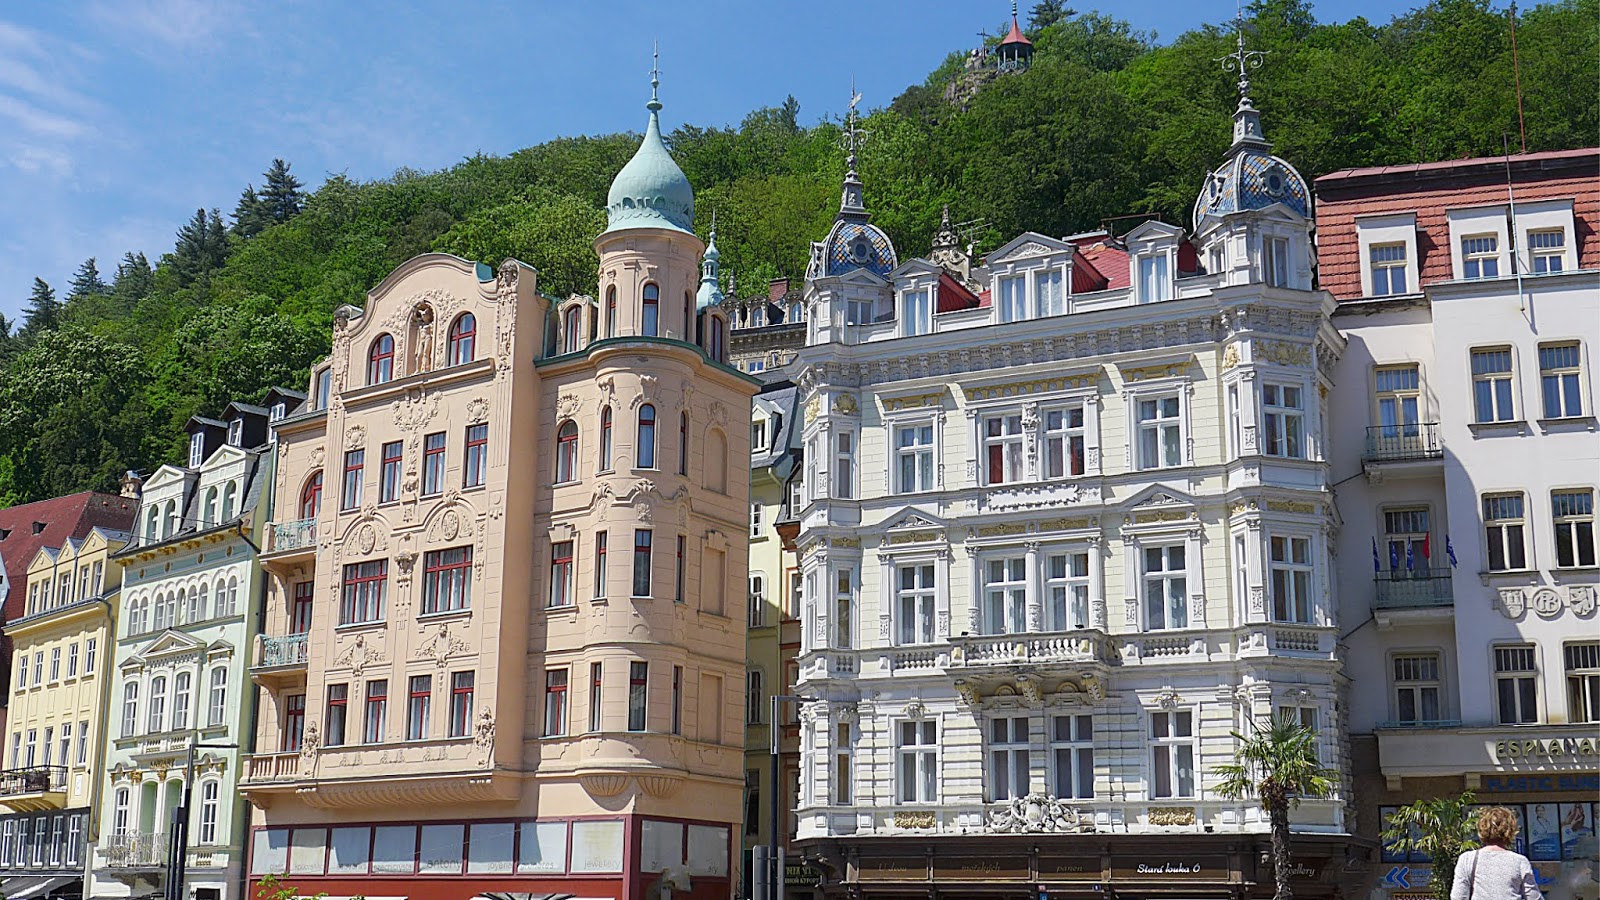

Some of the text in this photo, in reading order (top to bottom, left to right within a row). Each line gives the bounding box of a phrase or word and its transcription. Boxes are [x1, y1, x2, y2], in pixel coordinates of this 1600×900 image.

[1487, 777, 1553, 792] PLASTIC
[1056, 864, 1083, 872] panen
[1136, 862, 1201, 874] Stará louka 6
